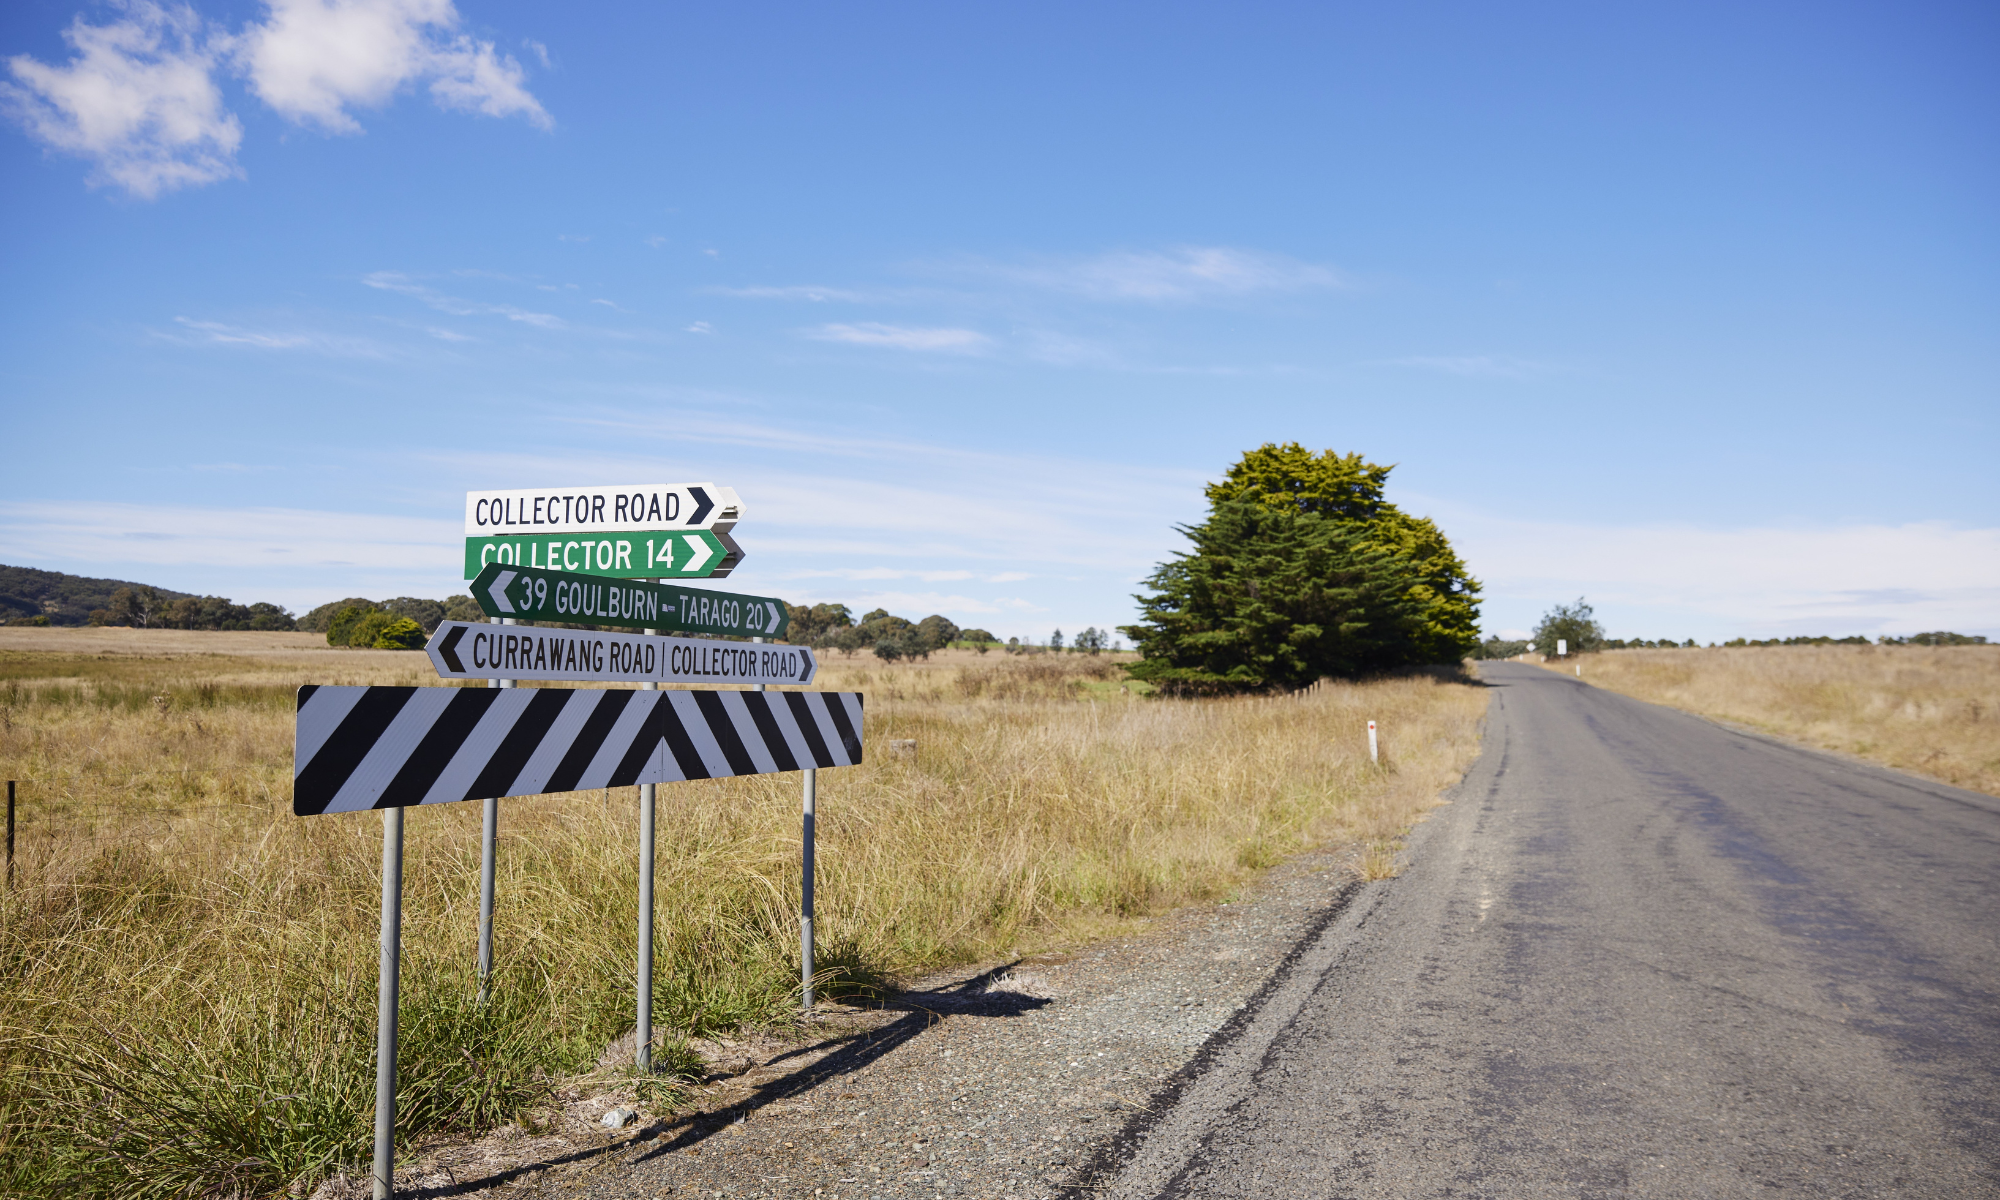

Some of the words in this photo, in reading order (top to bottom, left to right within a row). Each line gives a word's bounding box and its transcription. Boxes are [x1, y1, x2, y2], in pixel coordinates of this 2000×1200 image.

[476, 495, 605, 526] COLLECTOR
[614, 492, 680, 523] ROAD
[481, 540, 632, 570] COLLECTOR
[646, 538, 674, 569] 14
[519, 576, 548, 611] 39
[555, 580, 658, 621] GOULBURN
[679, 595, 739, 628] TARAGO
[745, 602, 763, 630] 20
[473, 632, 603, 673] CURRAWANG
[610, 641, 655, 674] ROAD
[671, 644, 757, 677] COLLECTOR
[761, 651, 797, 678] ROAD
